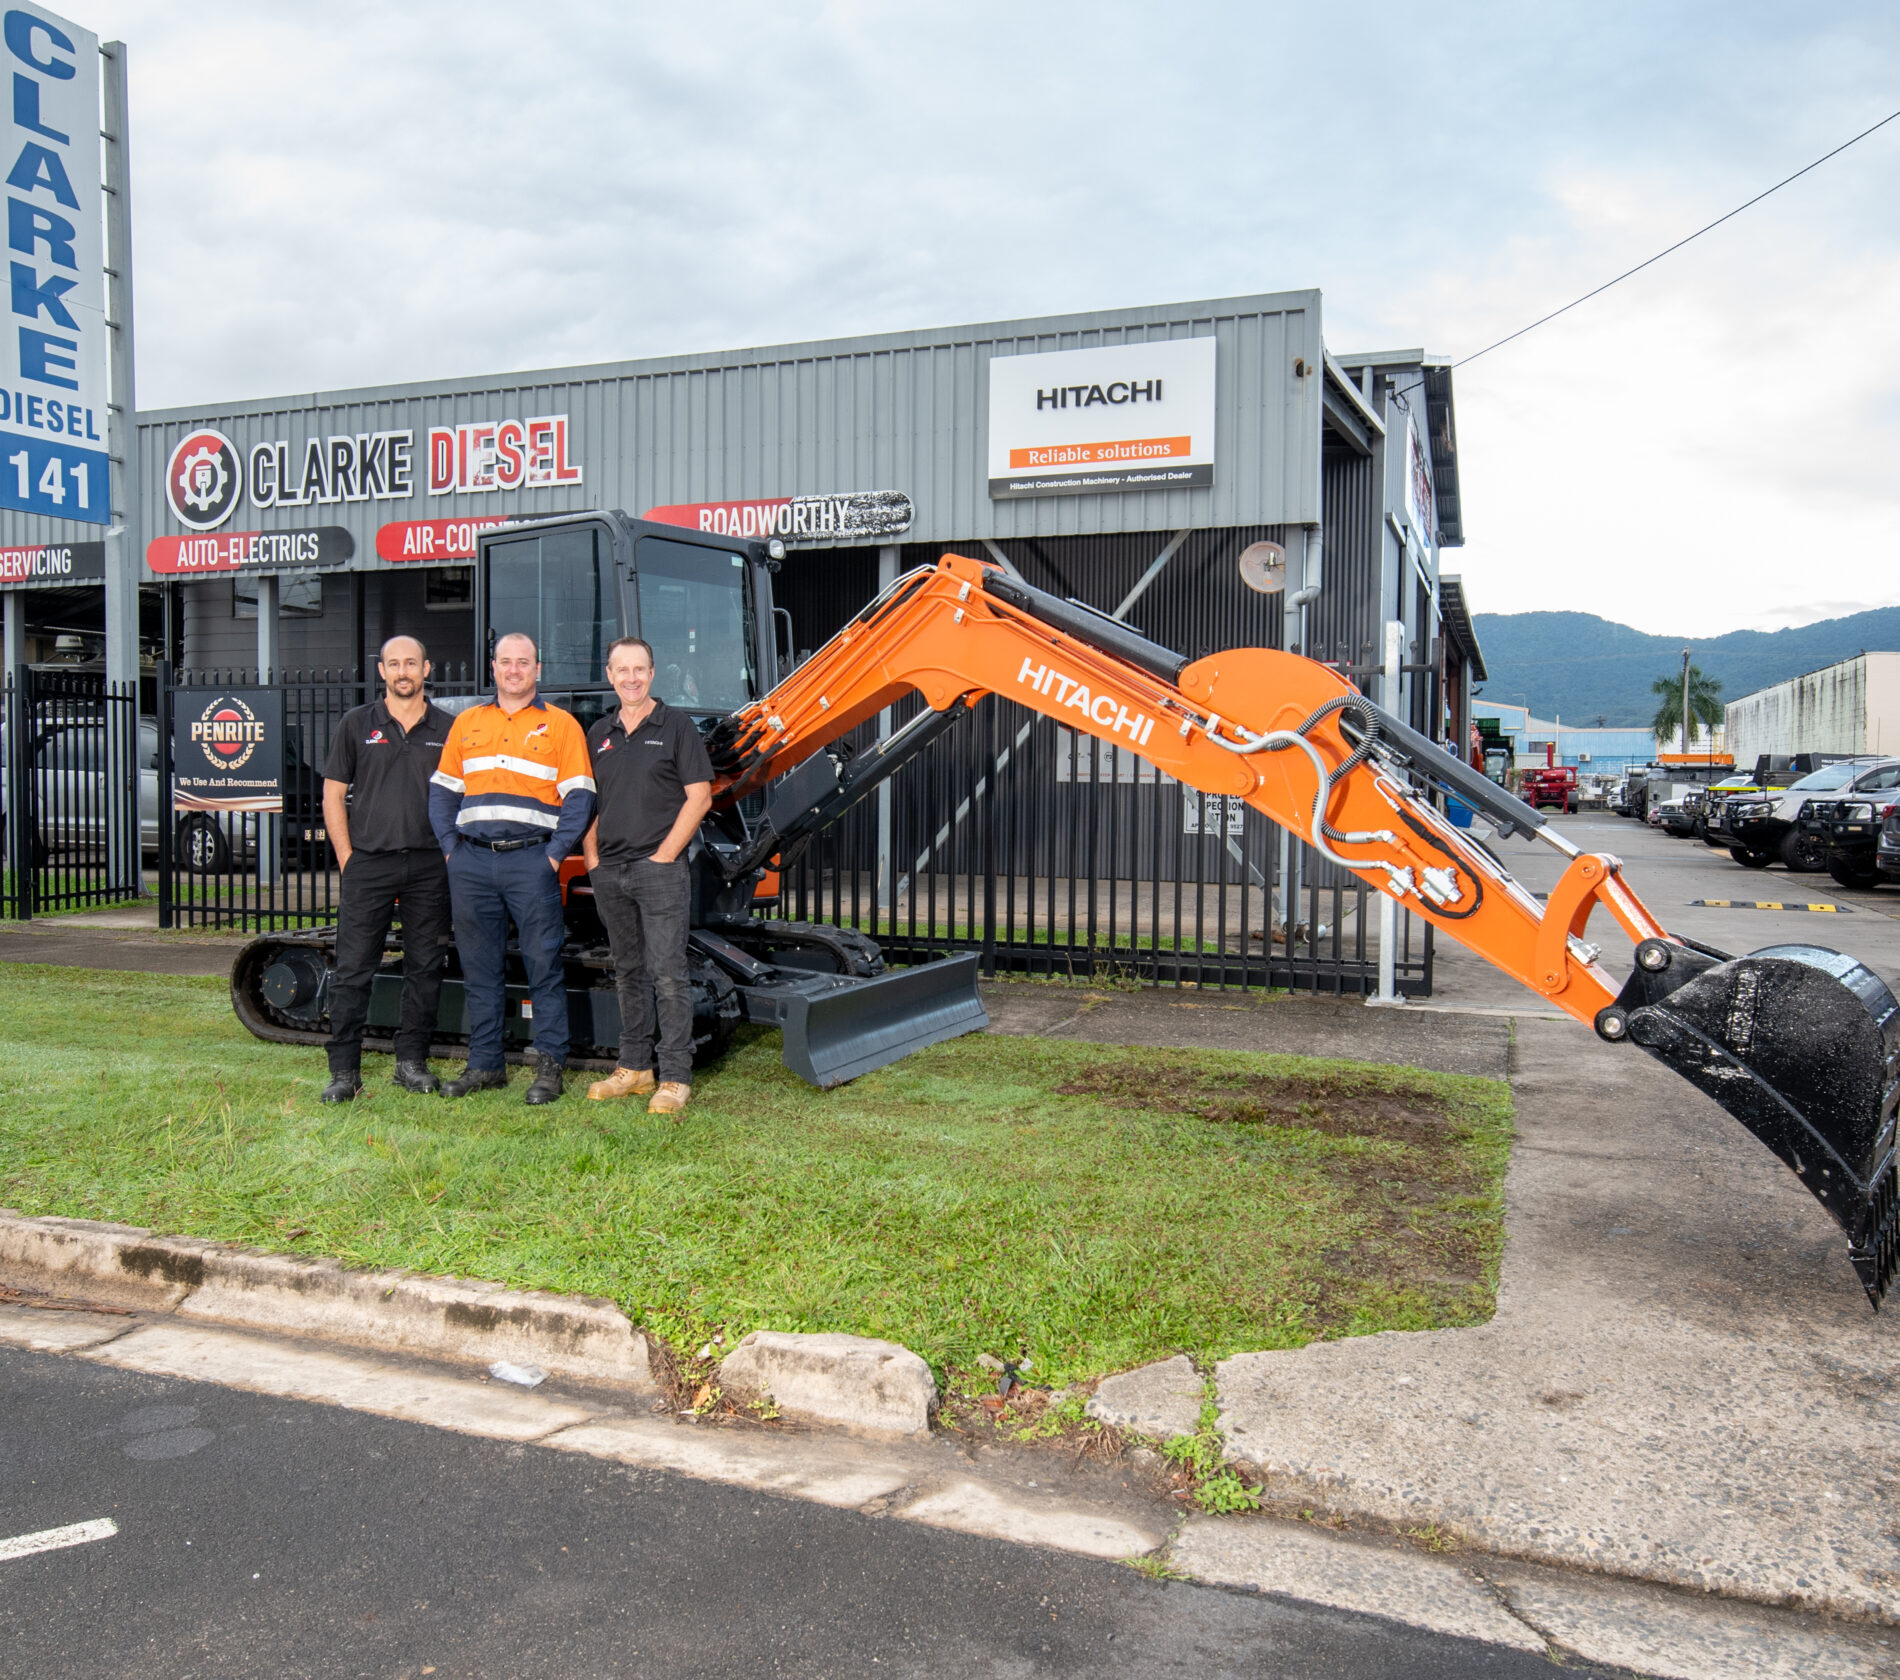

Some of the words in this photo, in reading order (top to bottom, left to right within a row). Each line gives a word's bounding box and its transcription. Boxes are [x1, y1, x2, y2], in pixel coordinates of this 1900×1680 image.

[4, 10, 81, 391] CLARKE
[1036, 379, 1162, 410] HITACHI
[0, 388, 100, 441] DIESEL
[250, 430, 413, 507] CLARKE
[428, 415, 583, 495] DIESEL
[1029, 447, 1091, 465] Reliable
[1097, 442, 1171, 460] solutions
[9, 450, 89, 509] 141
[1010, 481, 1034, 490] Hitachi
[1035, 479, 1081, 489] Construction
[1082, 476, 1120, 486] Machinery
[1126, 473, 1167, 483] Authorised
[1168, 471, 1193, 480] Dealer
[699, 500, 850, 537] ROADWORTHY
[177, 533, 319, 567] AUTO-ELECTRICS
[1016, 657, 1155, 746] HITACHI
[191, 722, 264, 741] PENRITE
[179, 777, 191, 786] We
[193, 777, 207, 786] Use
[209, 778, 226, 787] And
[227, 778, 278, 787] Recommend
